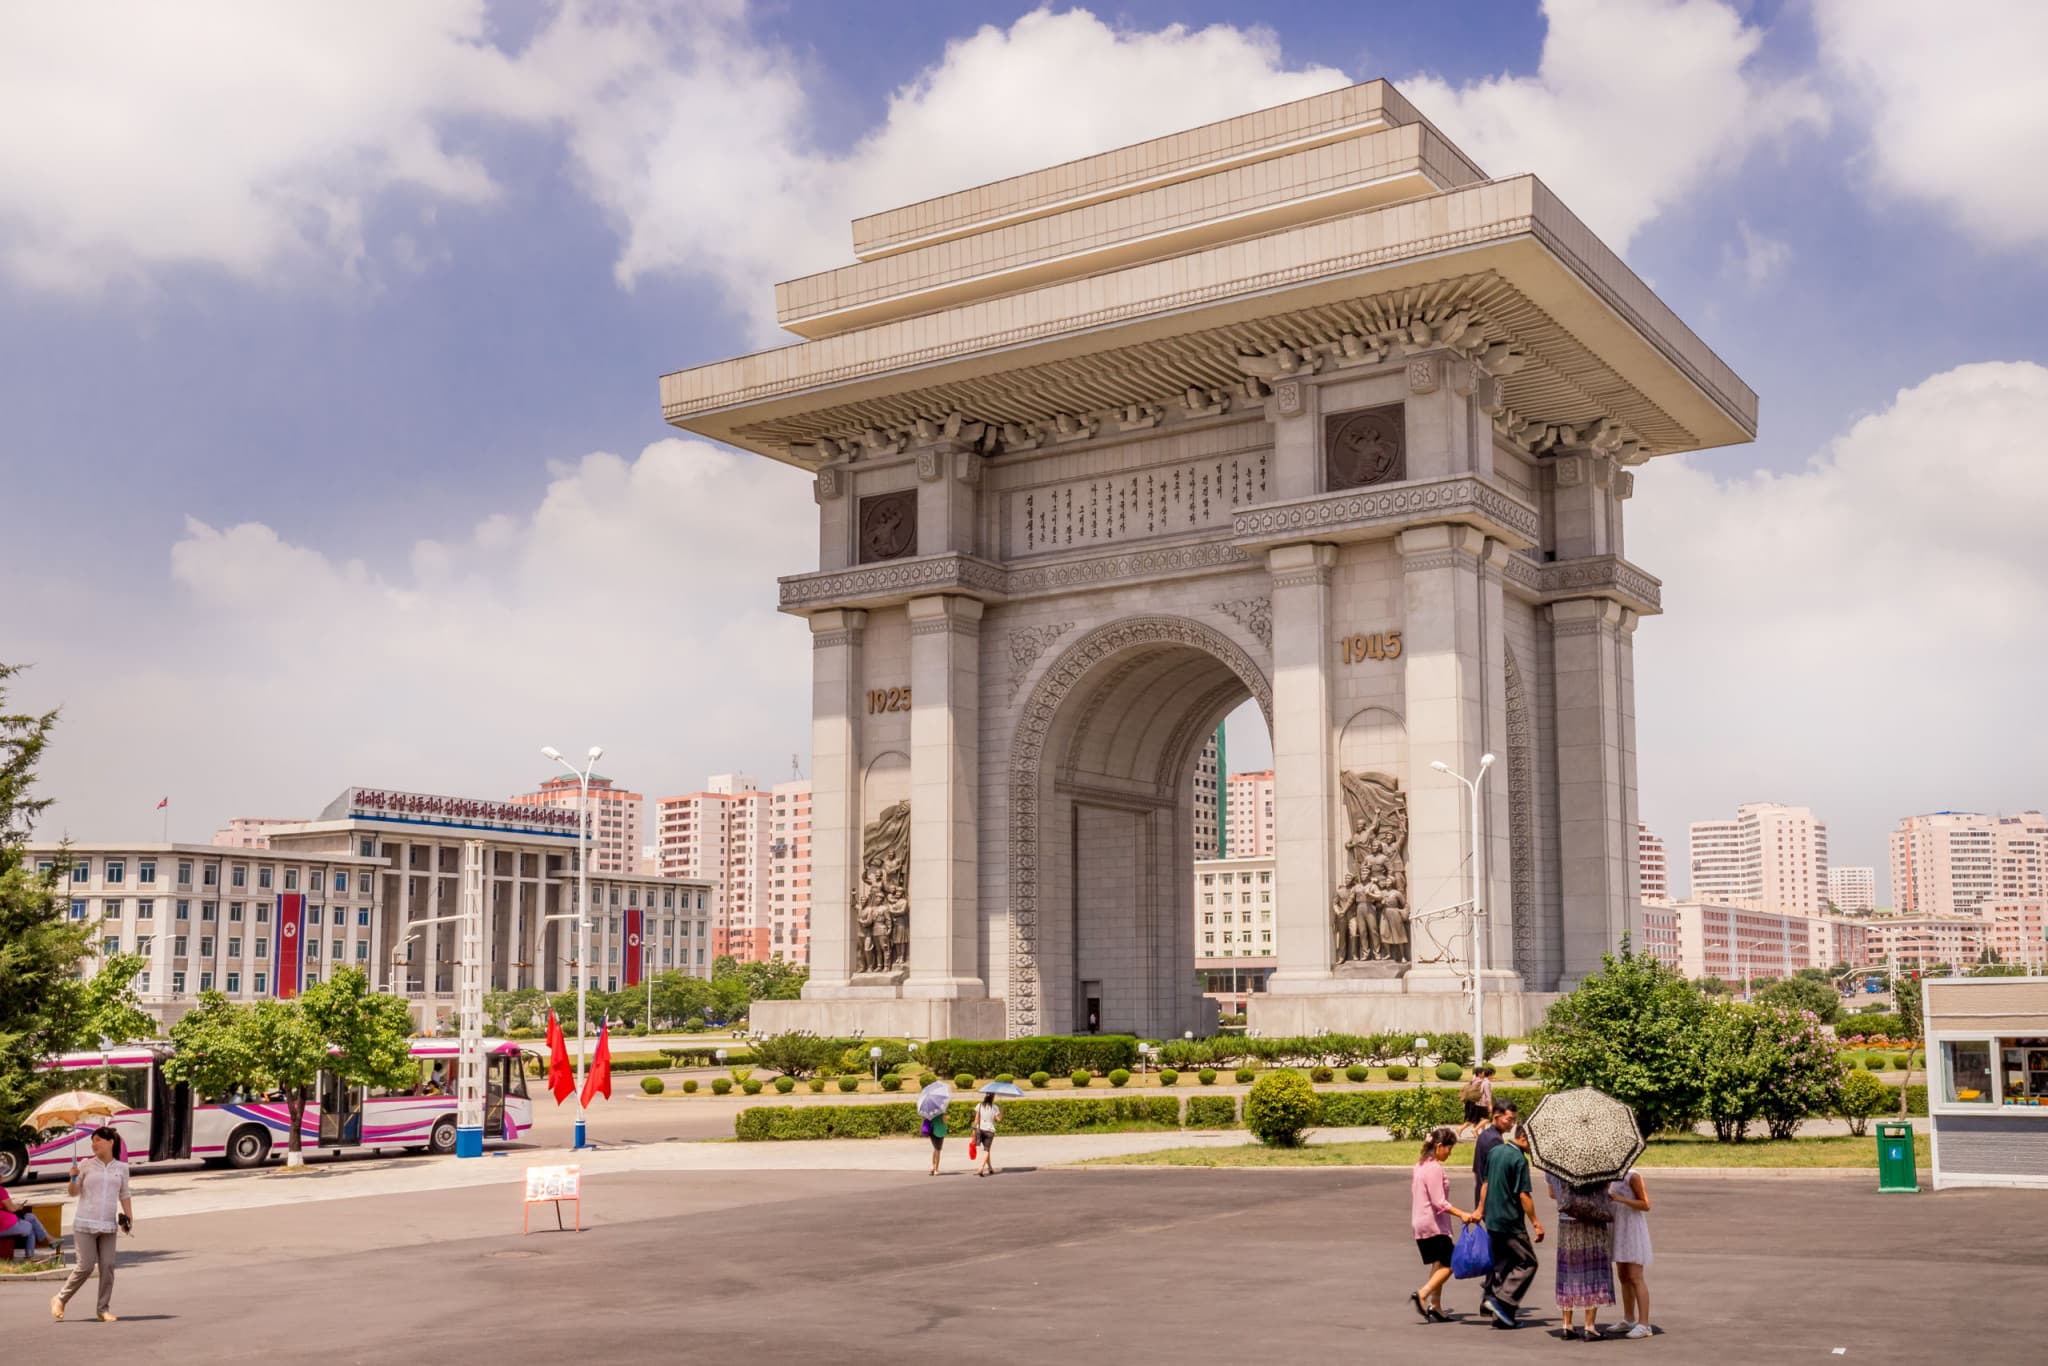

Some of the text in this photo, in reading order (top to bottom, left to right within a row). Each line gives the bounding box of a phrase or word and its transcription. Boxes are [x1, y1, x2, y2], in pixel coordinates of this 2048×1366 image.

[1342, 631, 1402, 664] 1945
[867, 686, 912, 714] 1925
[354, 790, 386, 809] 위대한
[387, 793, 443, 813] 김일성동지와
[444, 798, 496, 819] 김정일동지는
